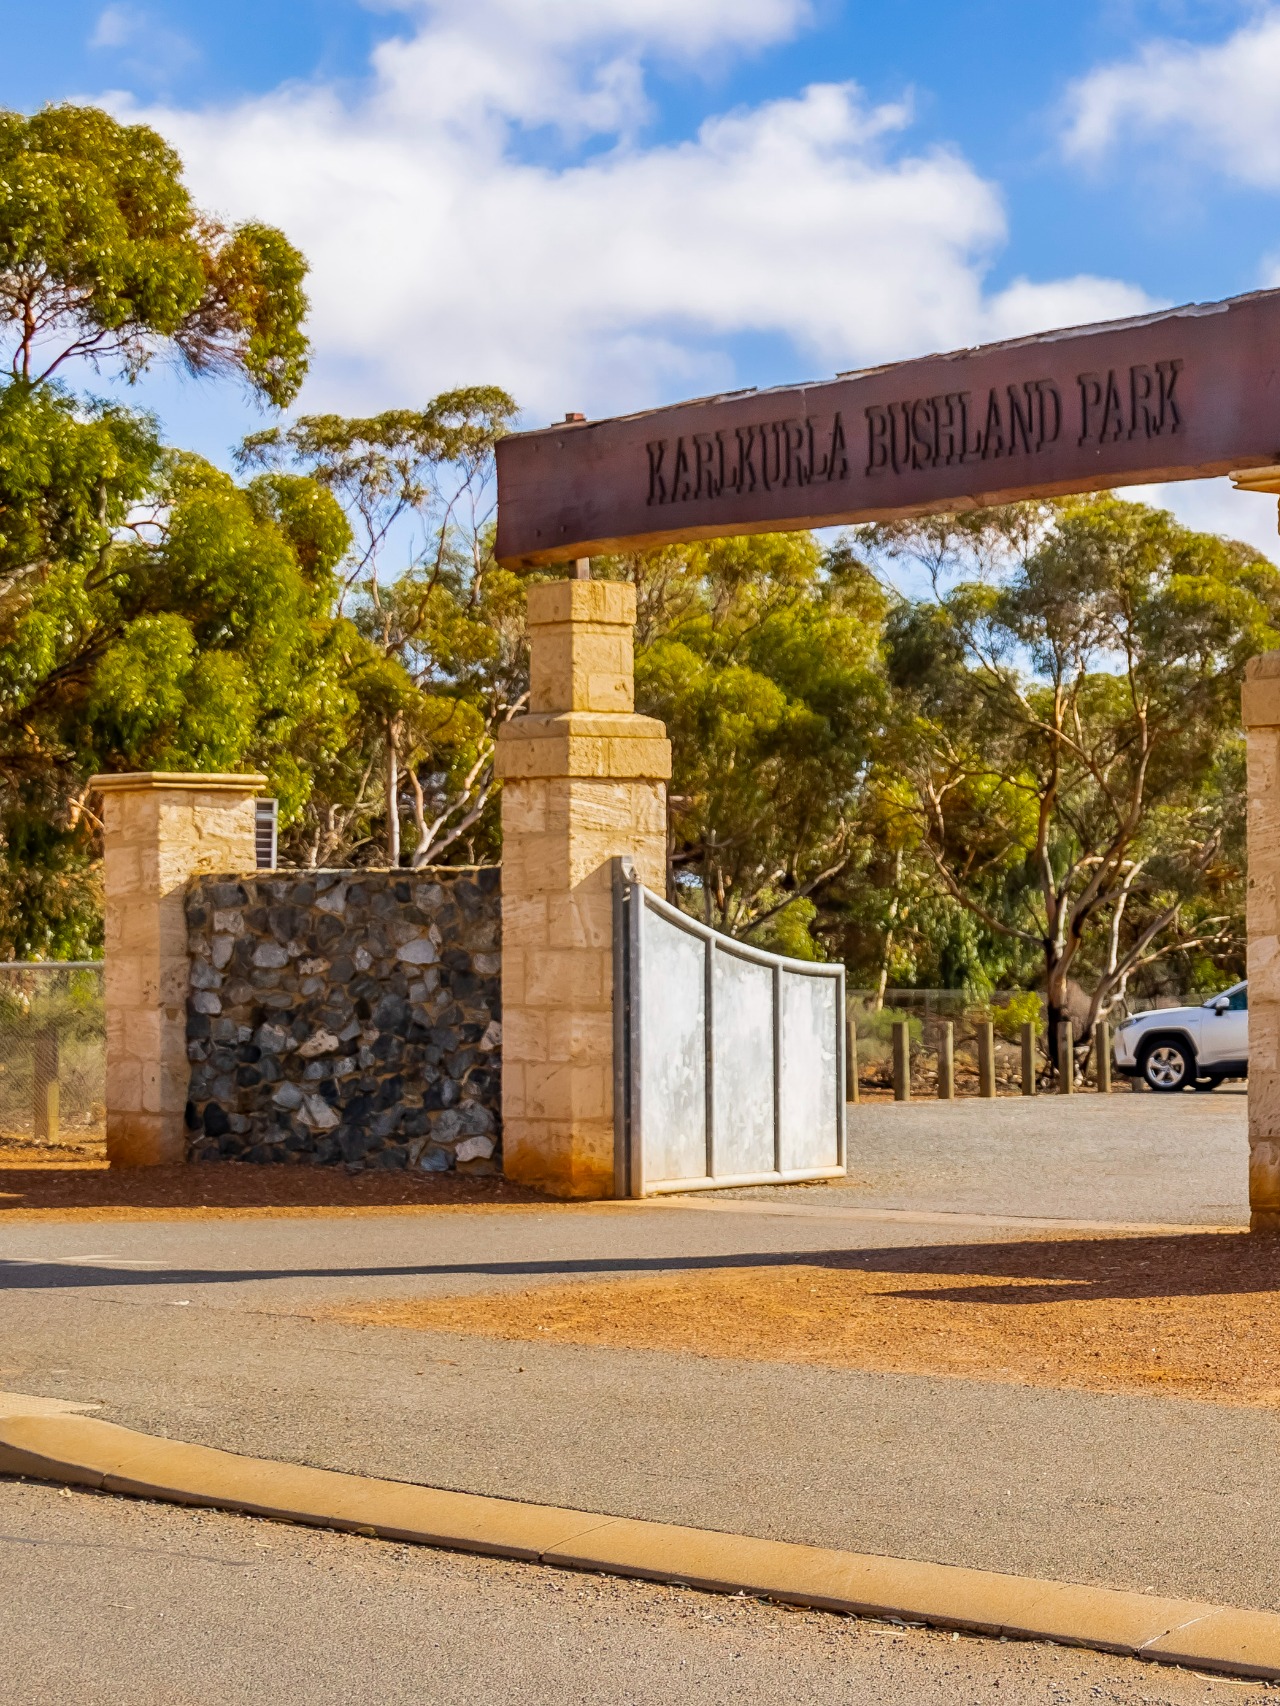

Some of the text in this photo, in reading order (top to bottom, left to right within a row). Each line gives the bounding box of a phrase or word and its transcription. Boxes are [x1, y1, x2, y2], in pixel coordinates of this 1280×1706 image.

[646, 411, 849, 507] KARLKURLA
[864, 378, 1063, 476] BUSHLAND
[1077, 357, 1185, 447] PARK
